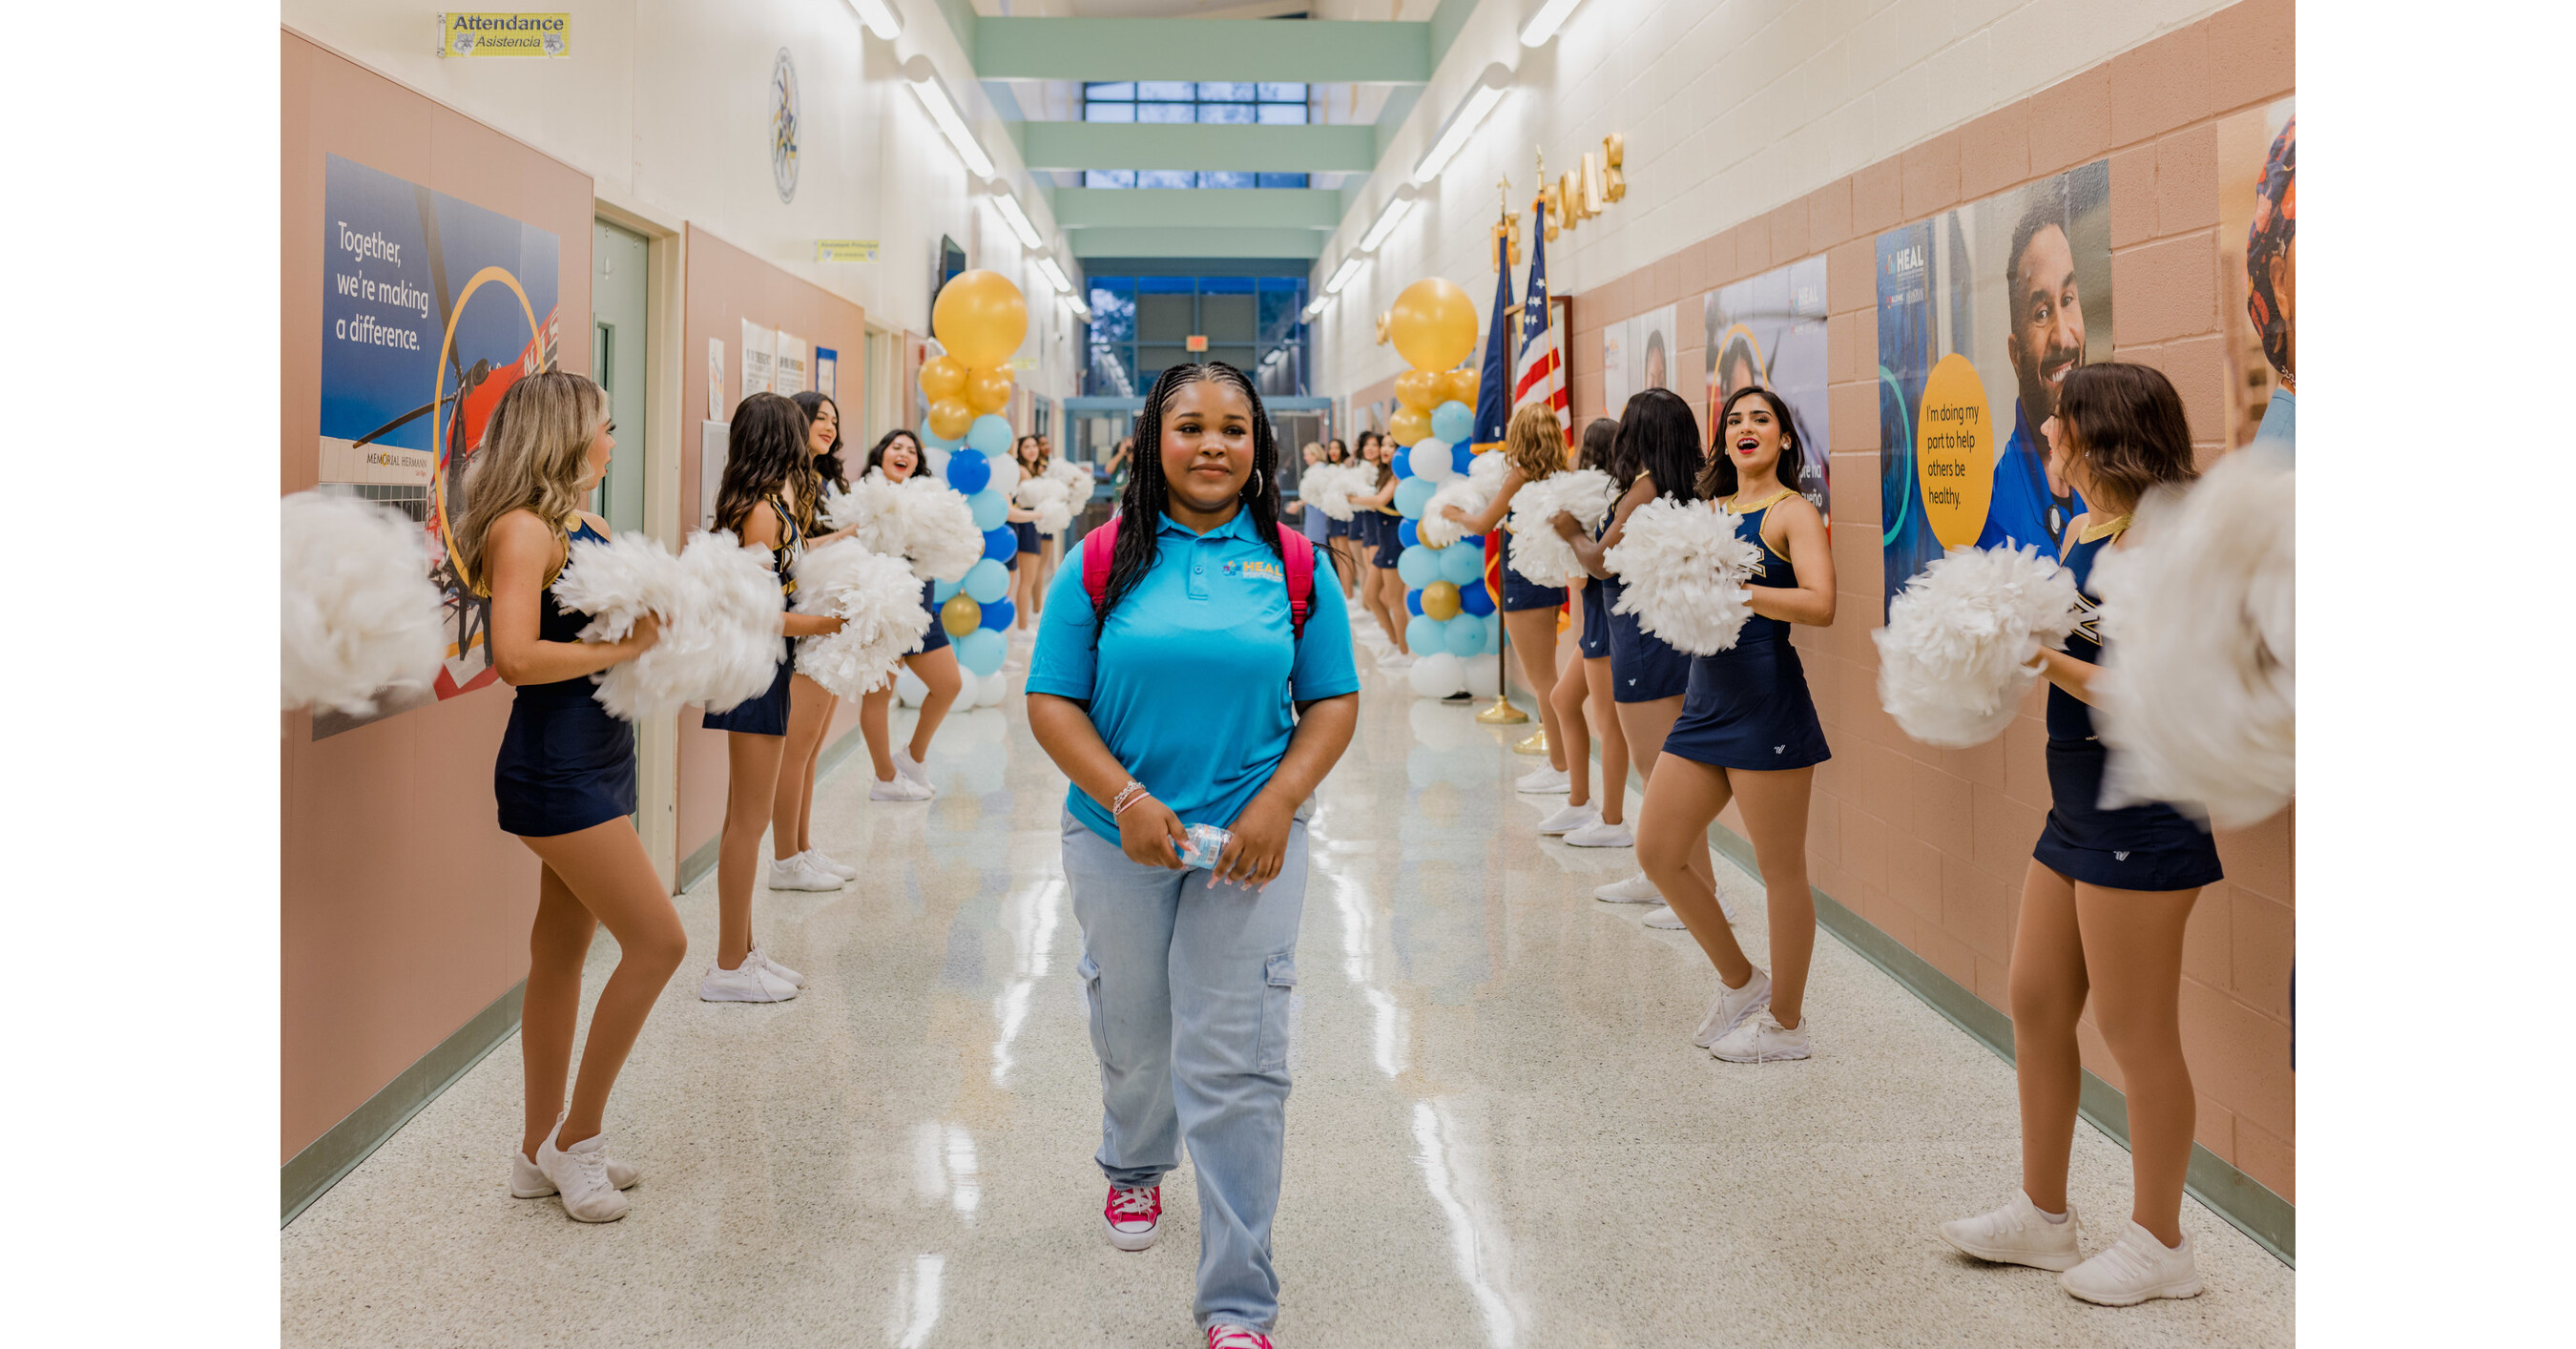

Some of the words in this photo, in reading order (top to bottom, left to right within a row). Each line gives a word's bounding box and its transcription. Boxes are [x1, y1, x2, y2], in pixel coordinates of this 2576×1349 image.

[453, 14, 564, 31] Attendance
[475, 35, 541, 48] Asistencia
[338, 220, 401, 268] Together,
[1897, 244, 1924, 273] HEAL
[337, 269, 376, 301] we're
[379, 280, 428, 319] making
[336, 318, 346, 341] a
[349, 313, 420, 351] difference.
[1926, 405, 1939, 422] I'm
[1940, 403, 1964, 425] doing
[1965, 405, 1980, 425] my
[1927, 432, 1944, 454] part
[1946, 432, 1955, 449] to
[1956, 429, 1976, 453] help
[366, 452, 400, 467] MEMORIAL
[401, 456, 427, 468] HERMANN
[1812, 459, 1821, 479] ha
[1927, 459, 1954, 477] others
[1954, 458, 1965, 477] be
[1928, 486, 1961, 510] healthy.
[1243, 560, 1283, 577] HEAL
